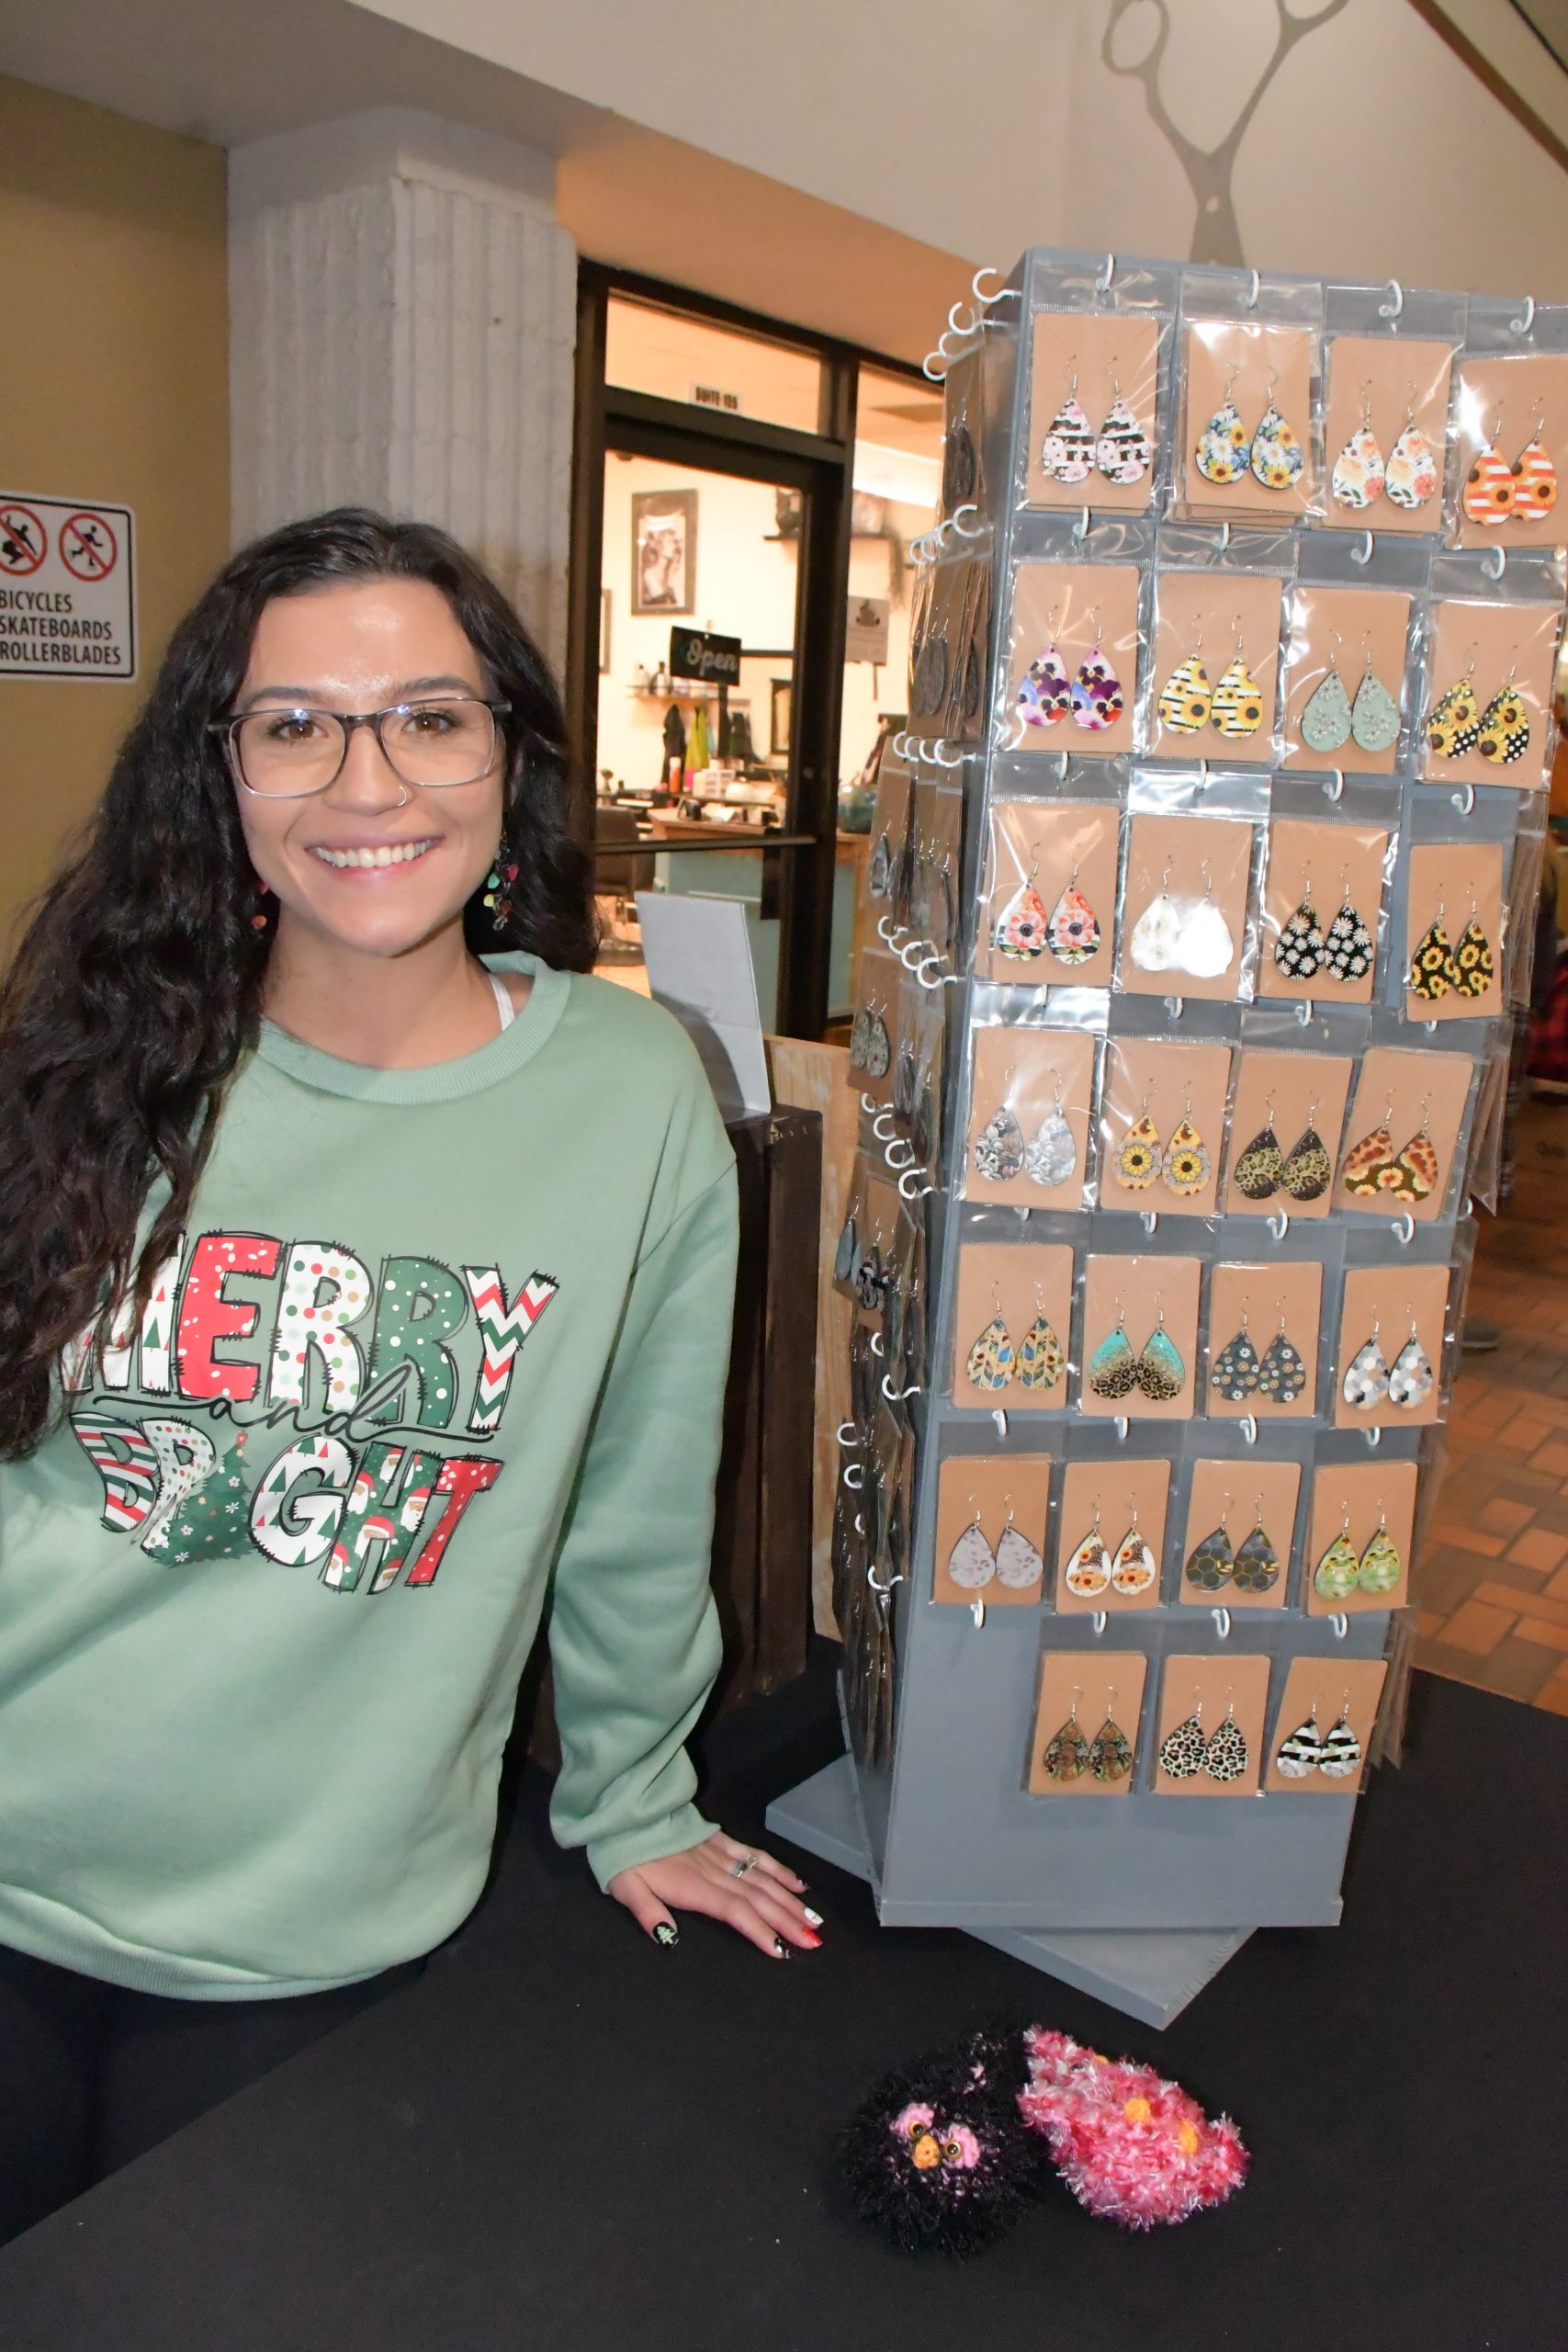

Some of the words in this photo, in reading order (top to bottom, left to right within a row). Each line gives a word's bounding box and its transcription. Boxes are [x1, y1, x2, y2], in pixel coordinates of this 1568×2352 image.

[0, 590, 73, 613] BICYCLES
[0, 616, 112, 640] SKATEBOARDS
[0, 640, 120, 665] ROLLERBLADES
[686, 638, 738, 677] Open
